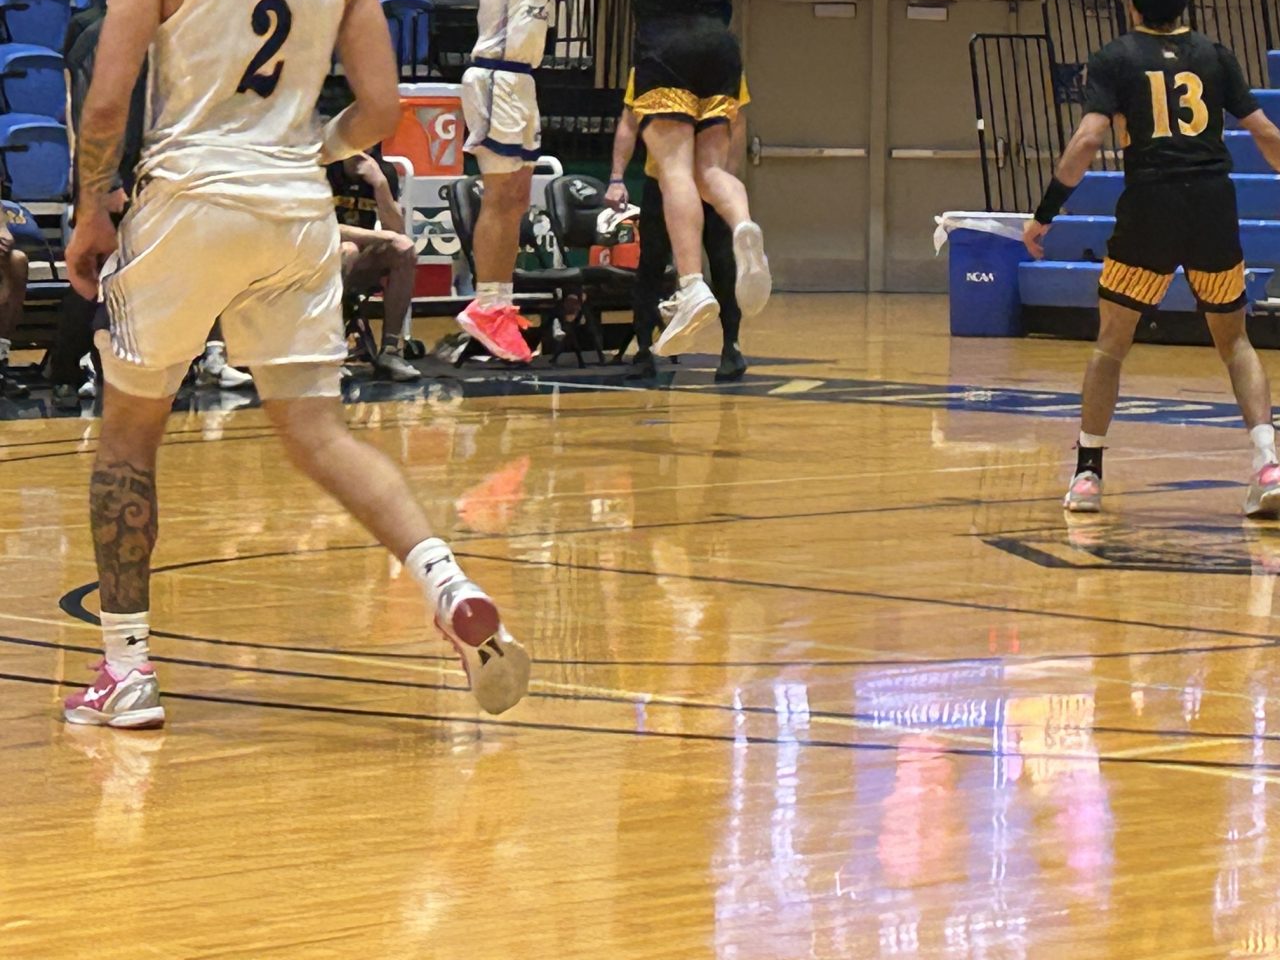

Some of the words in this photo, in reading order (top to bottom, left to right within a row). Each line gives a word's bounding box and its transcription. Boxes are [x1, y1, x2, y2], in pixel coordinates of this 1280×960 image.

[1144, 70, 1209, 139] 13
[434, 113, 457, 141] G
[966, 271, 995, 282] NCAA
